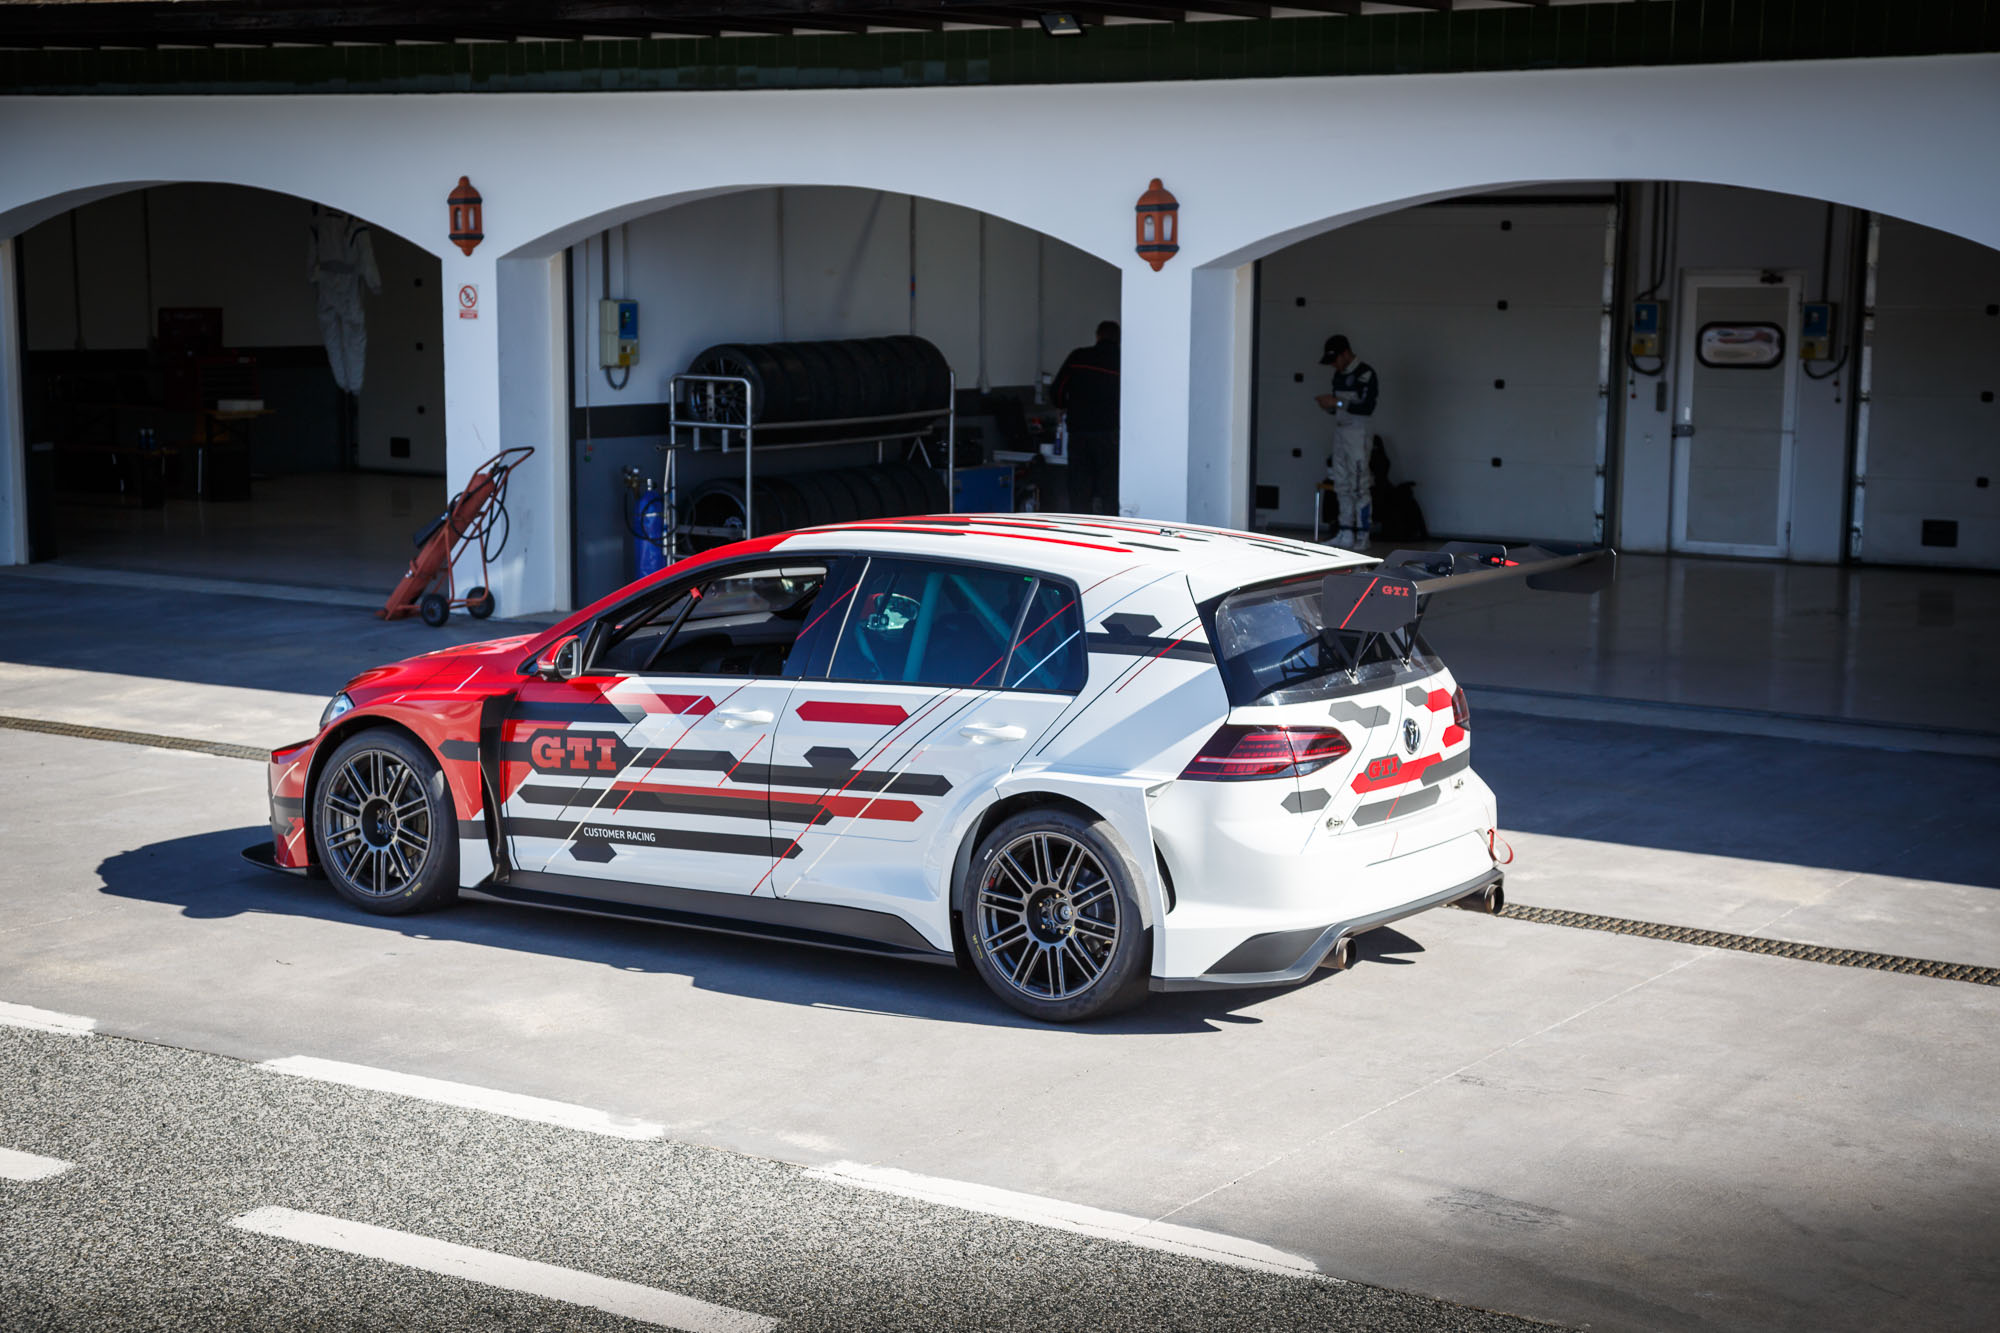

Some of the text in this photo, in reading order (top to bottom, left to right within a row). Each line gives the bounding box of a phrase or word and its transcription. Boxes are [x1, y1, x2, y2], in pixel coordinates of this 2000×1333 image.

[1382, 586, 1409, 597] GTI
[531, 736, 617, 770] GTI
[1368, 756, 1399, 778] GTI
[583, 827, 656, 842] CUSTOMER RACING
